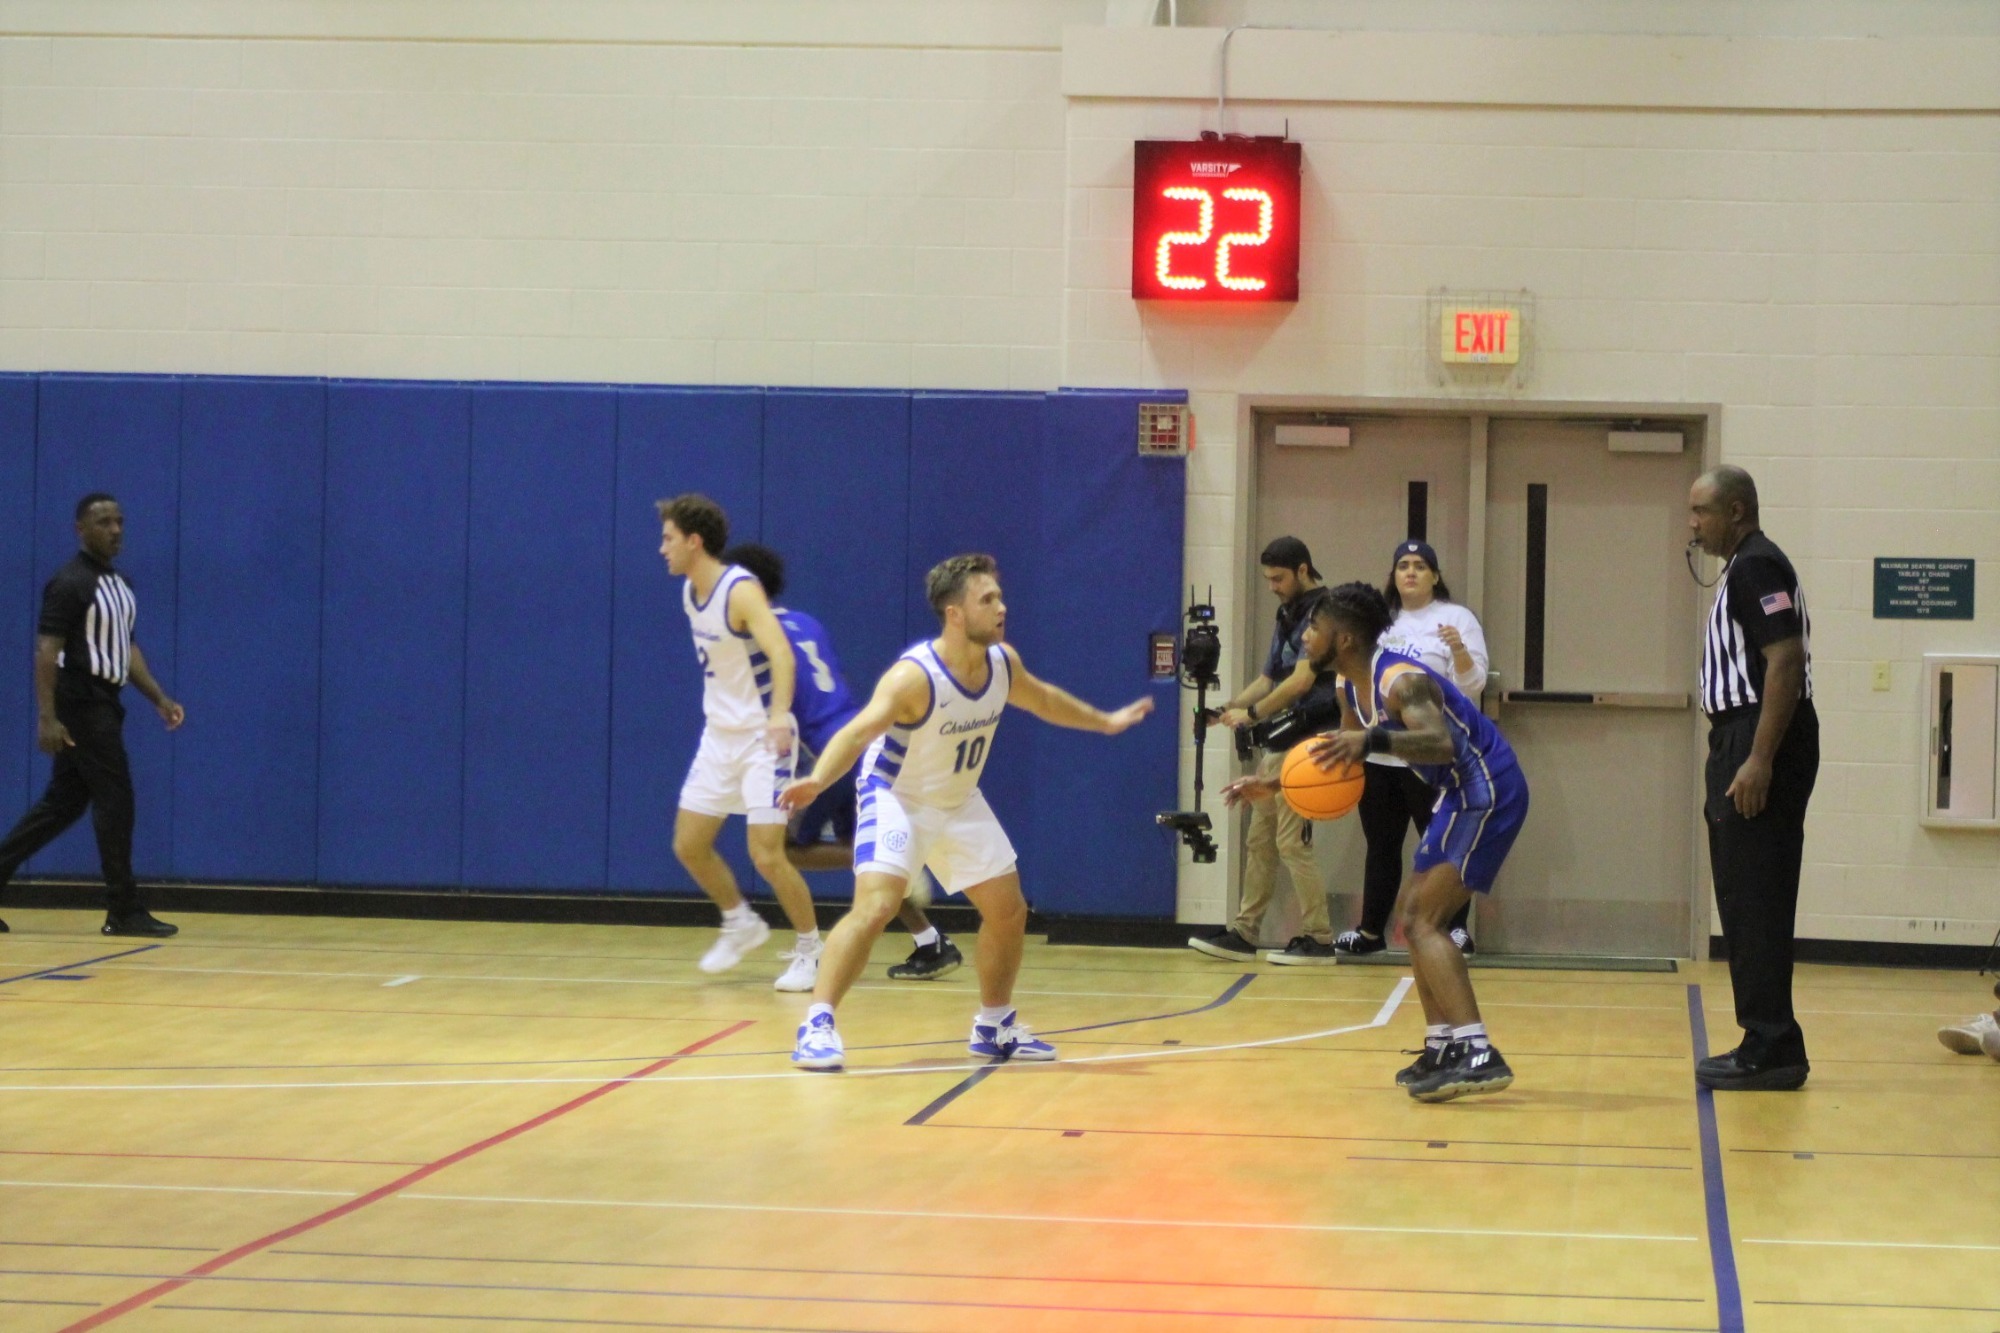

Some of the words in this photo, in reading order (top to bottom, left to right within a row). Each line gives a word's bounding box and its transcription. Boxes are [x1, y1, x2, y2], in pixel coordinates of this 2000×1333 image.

[1190, 162, 1228, 173] VARSITY
[1156, 187, 1273, 291] 22
[1455, 312, 1511, 354] EXIT
[953, 735, 986, 774] 10
